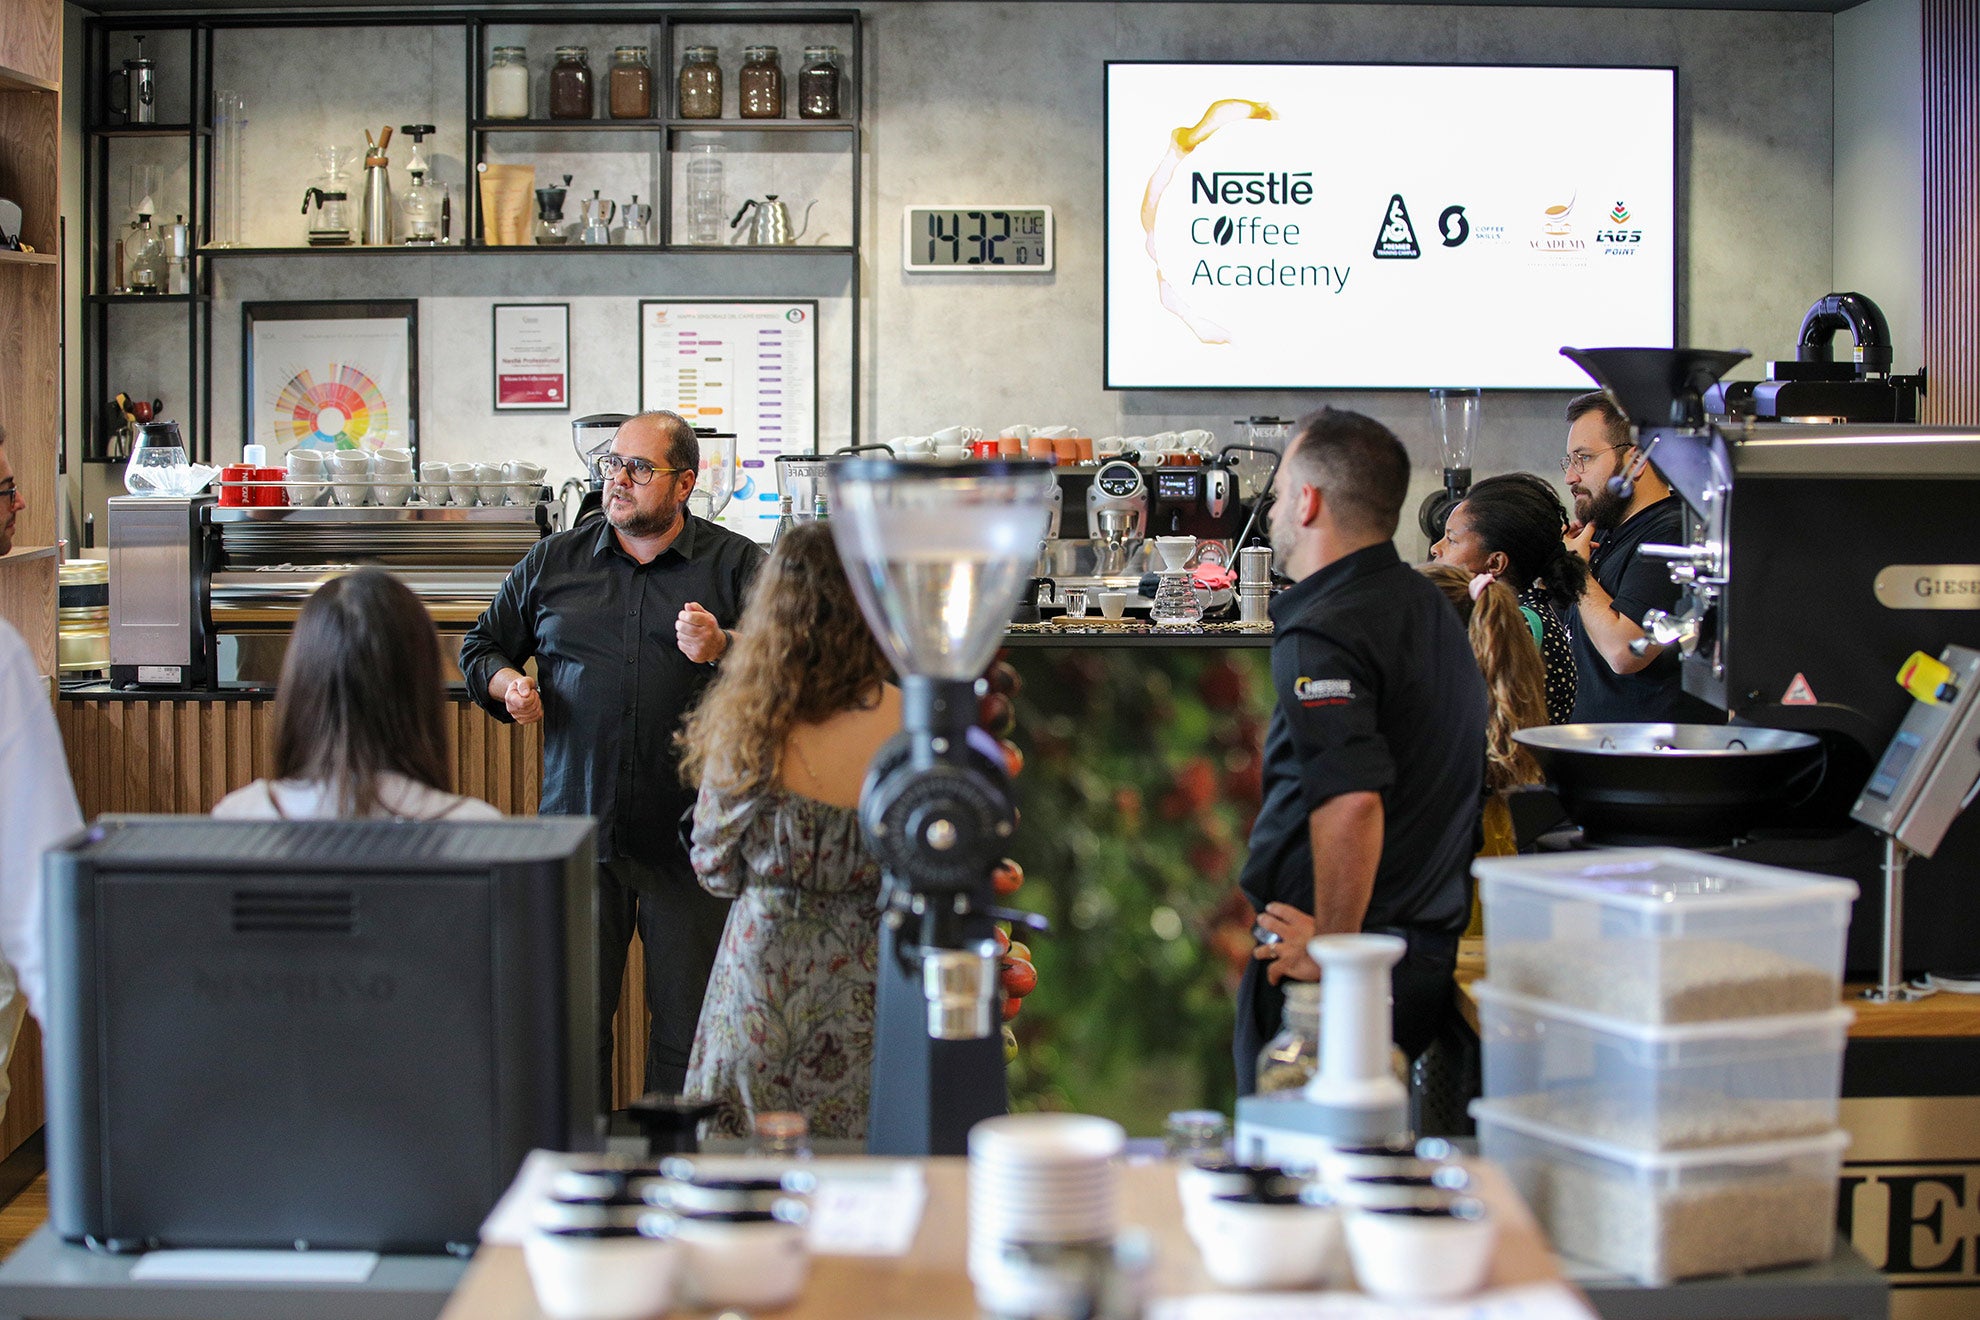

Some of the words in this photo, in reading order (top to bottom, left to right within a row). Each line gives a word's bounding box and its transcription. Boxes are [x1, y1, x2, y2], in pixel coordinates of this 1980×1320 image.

[1191, 171, 1313, 205] Nestlé
[1013, 216, 1043, 235] TUE
[1191, 215, 1300, 246] Coffee
[1529, 240, 1586, 249] ACADEMY
[1191, 258, 1351, 295] Academy
